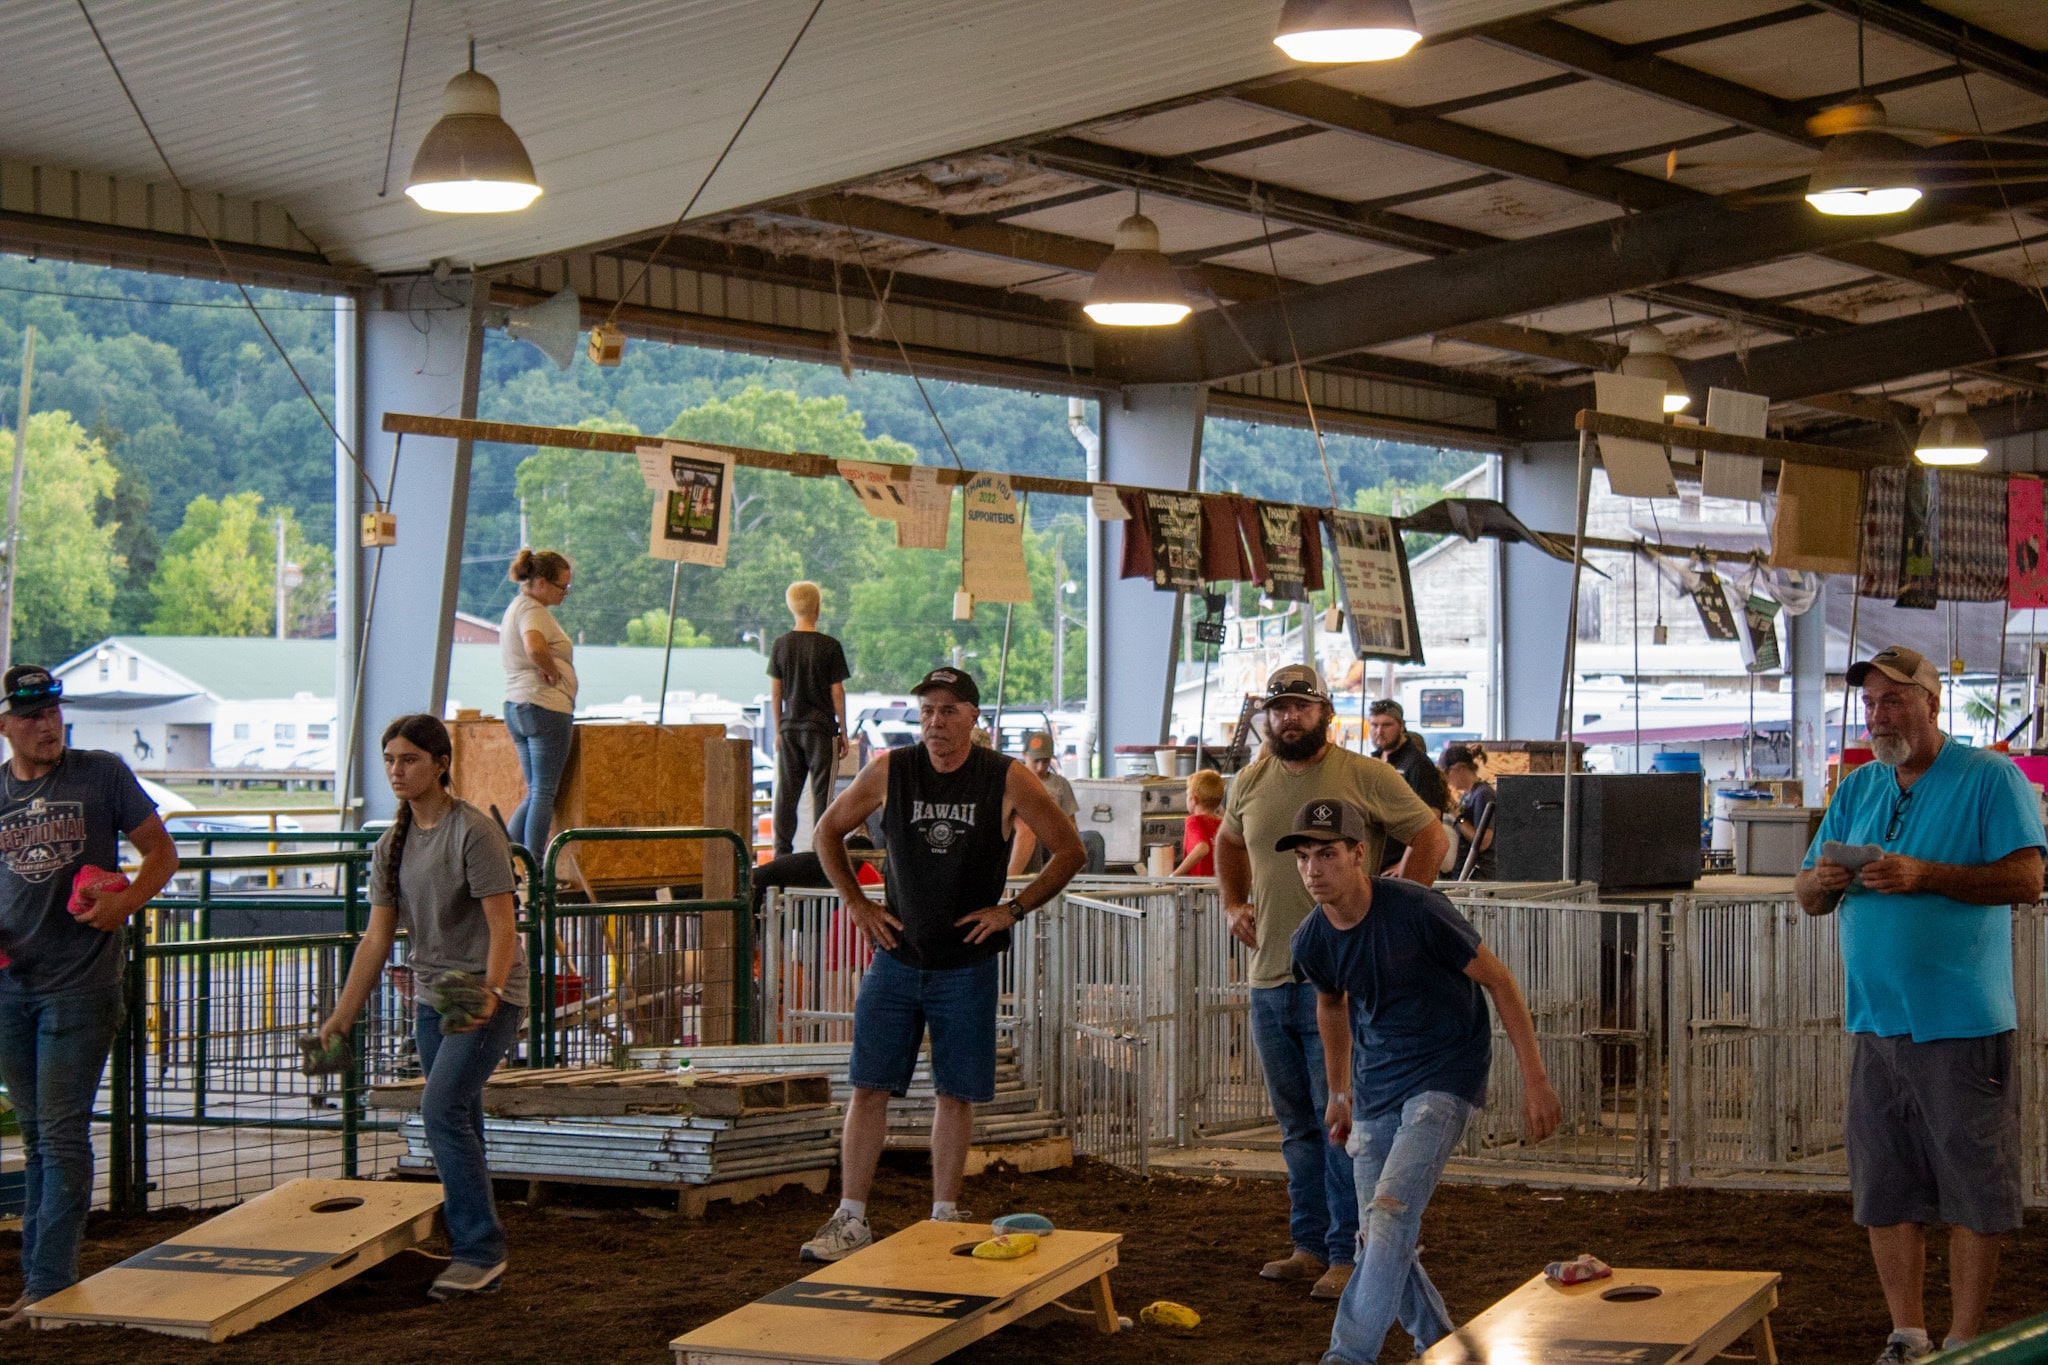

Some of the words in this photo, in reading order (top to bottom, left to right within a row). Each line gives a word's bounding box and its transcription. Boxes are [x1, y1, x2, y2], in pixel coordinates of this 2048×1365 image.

[966, 477, 993, 497] THANK
[996, 481, 1011, 501] YOU
[979, 491, 997, 504] 2022
[967, 509, 1016, 525] SUPPORTERS
[910, 800, 977, 826] HAWAII
[0, 817, 87, 851] ECTIONAL
